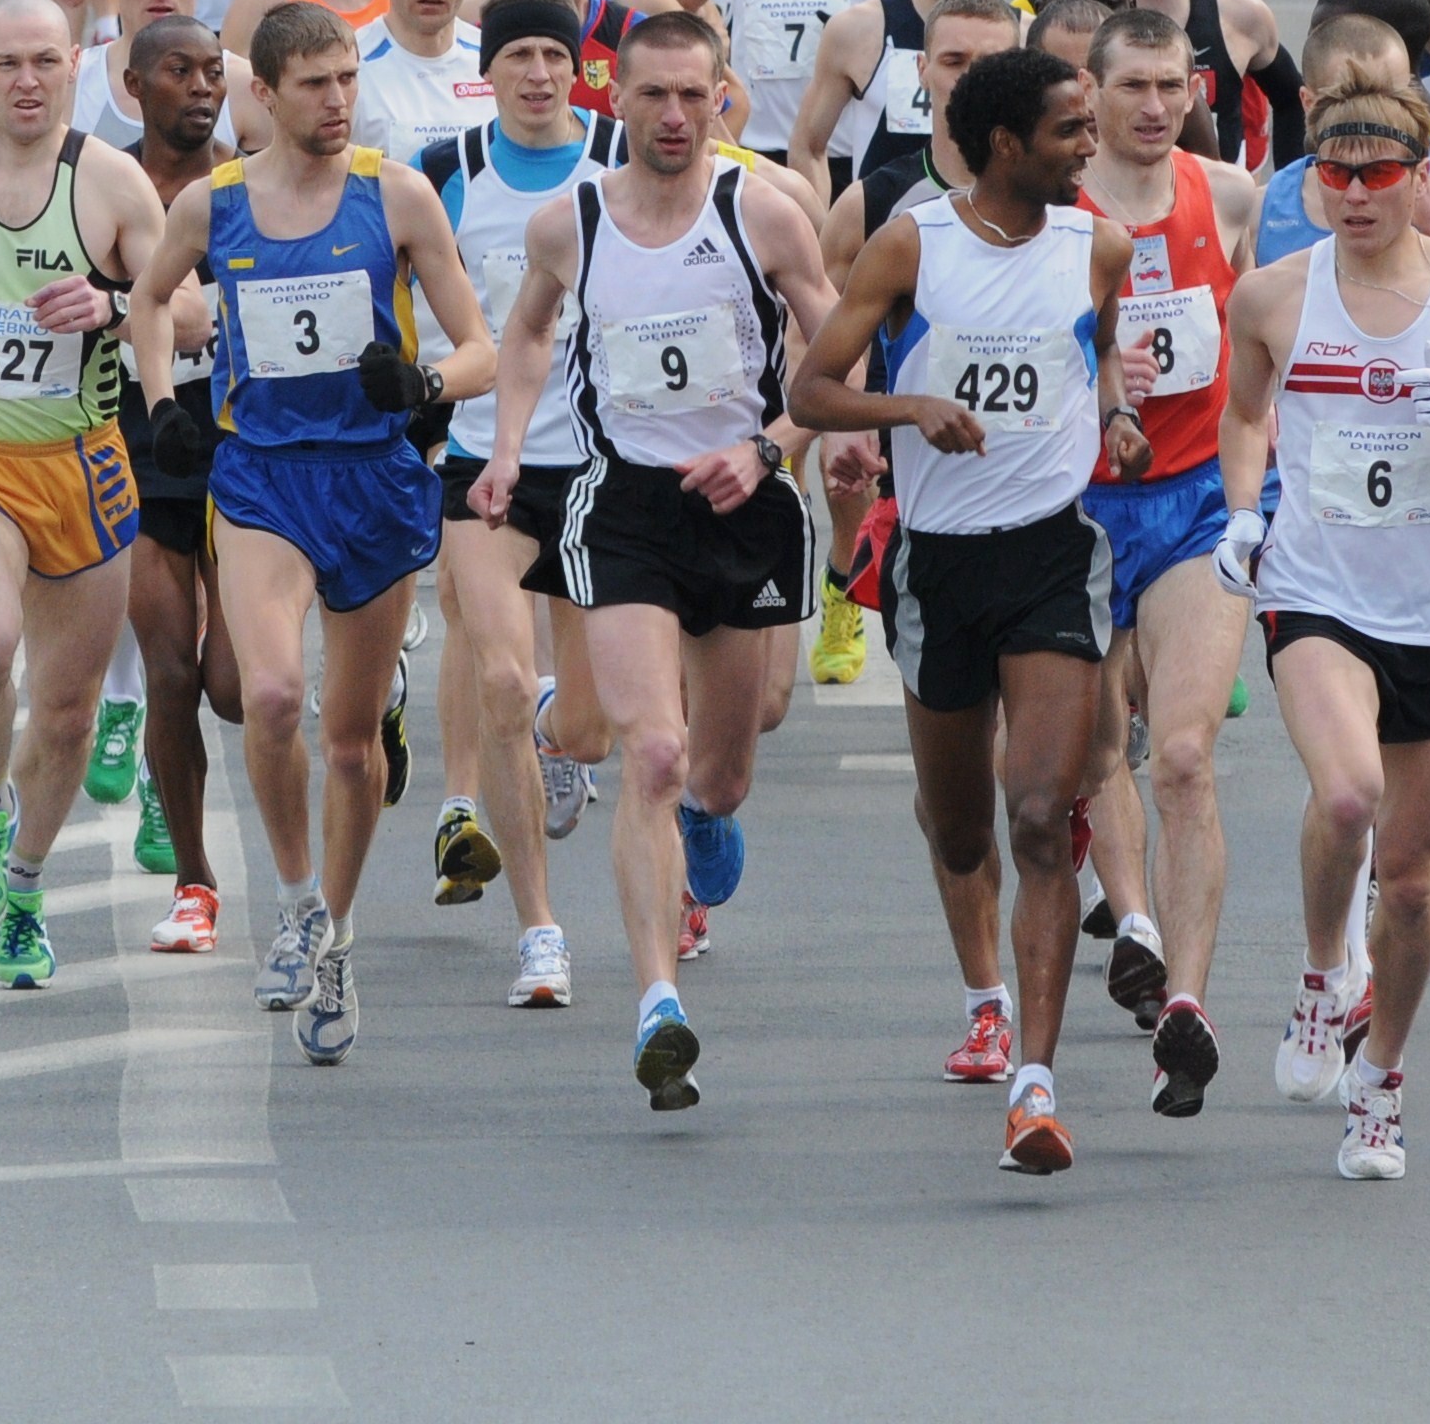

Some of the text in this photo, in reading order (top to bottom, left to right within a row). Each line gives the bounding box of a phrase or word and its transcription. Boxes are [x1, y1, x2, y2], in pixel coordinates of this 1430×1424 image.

[784, 23, 806, 62] 7
[16, 248, 74, 272] FILA
[683, 252, 726, 267] adidas
[293, 309, 320, 356] 3
[624, 314, 708, 333] MARATON
[660, 345, 689, 392] 9
[1151, 327, 1175, 375] 8
[954, 363, 1039, 413] 429
[1338, 430, 1422, 440] MARATON
[1366, 460, 1393, 508] 6
